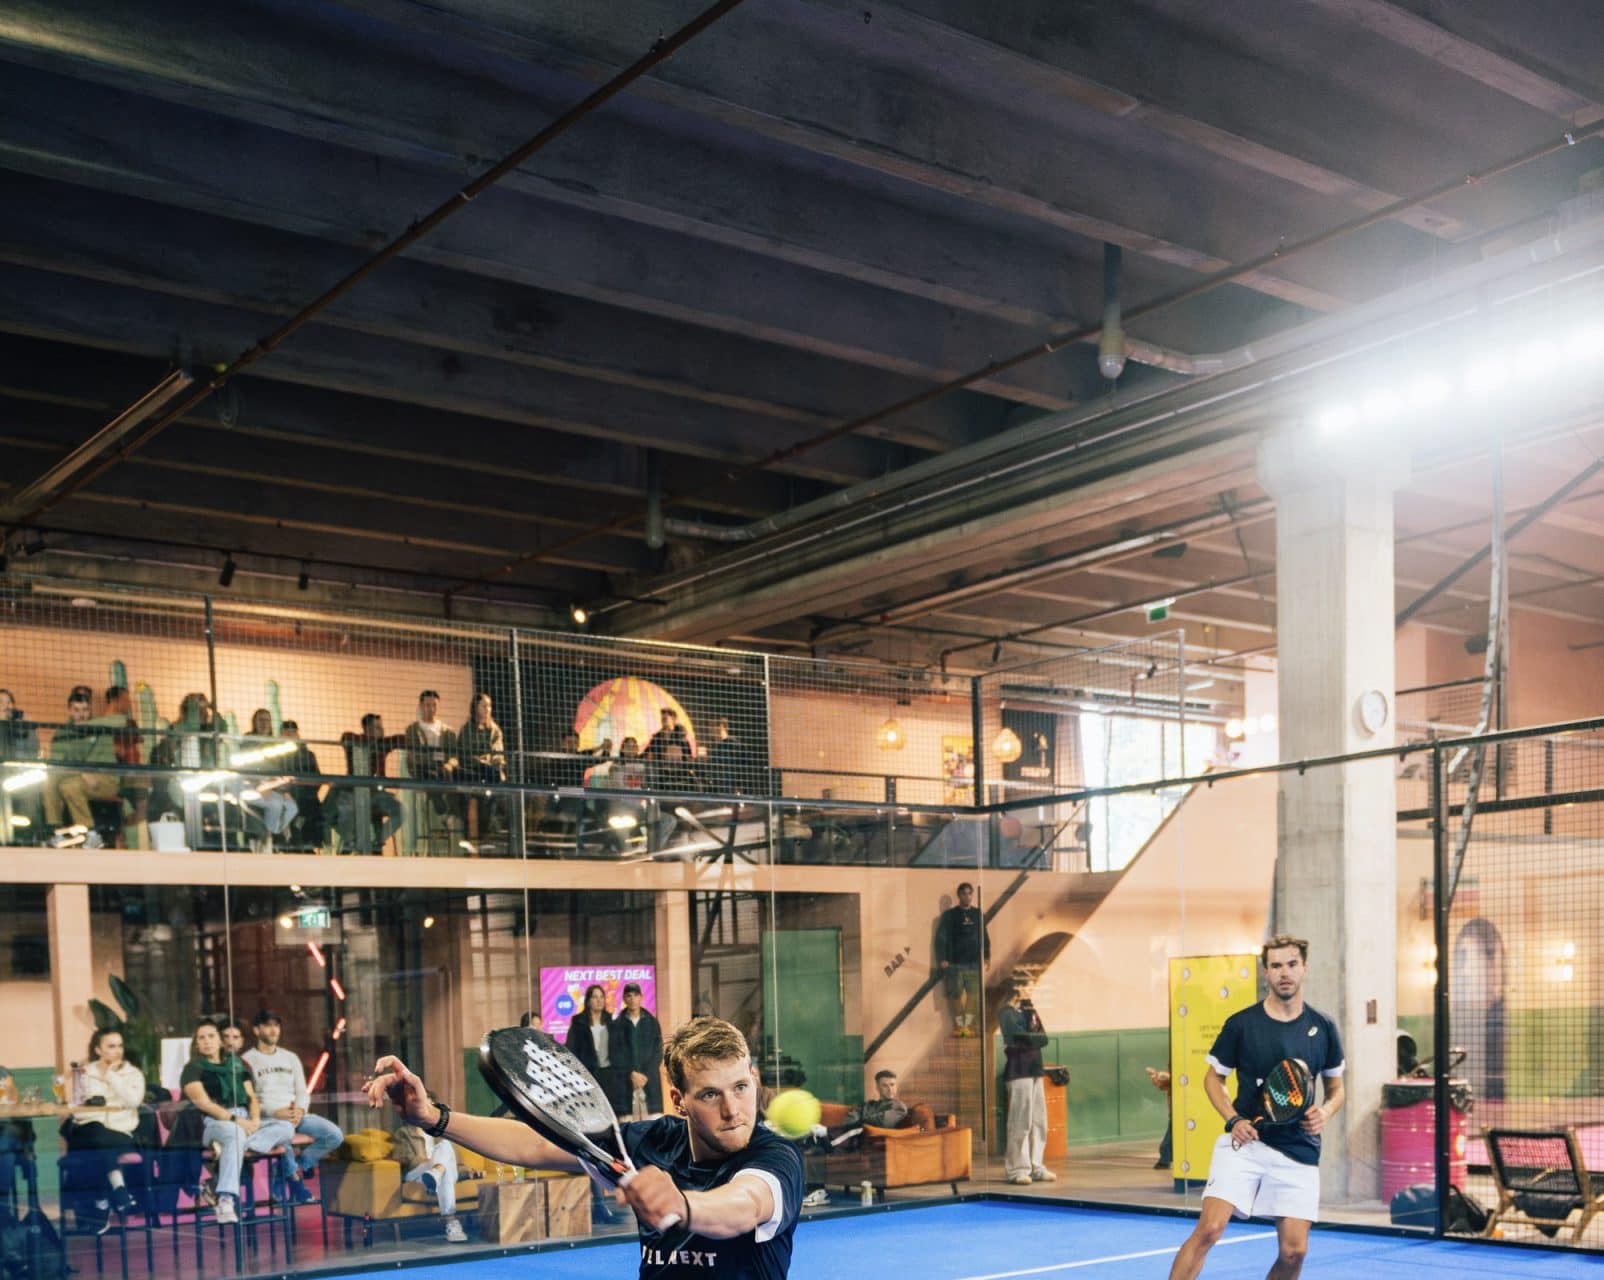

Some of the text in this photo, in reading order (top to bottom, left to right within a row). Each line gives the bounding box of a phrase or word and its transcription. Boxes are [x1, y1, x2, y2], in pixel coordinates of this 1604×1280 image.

[564, 969, 652, 981] NEXT BEST DEAL
[667, 1249, 717, 1267] NEXT
